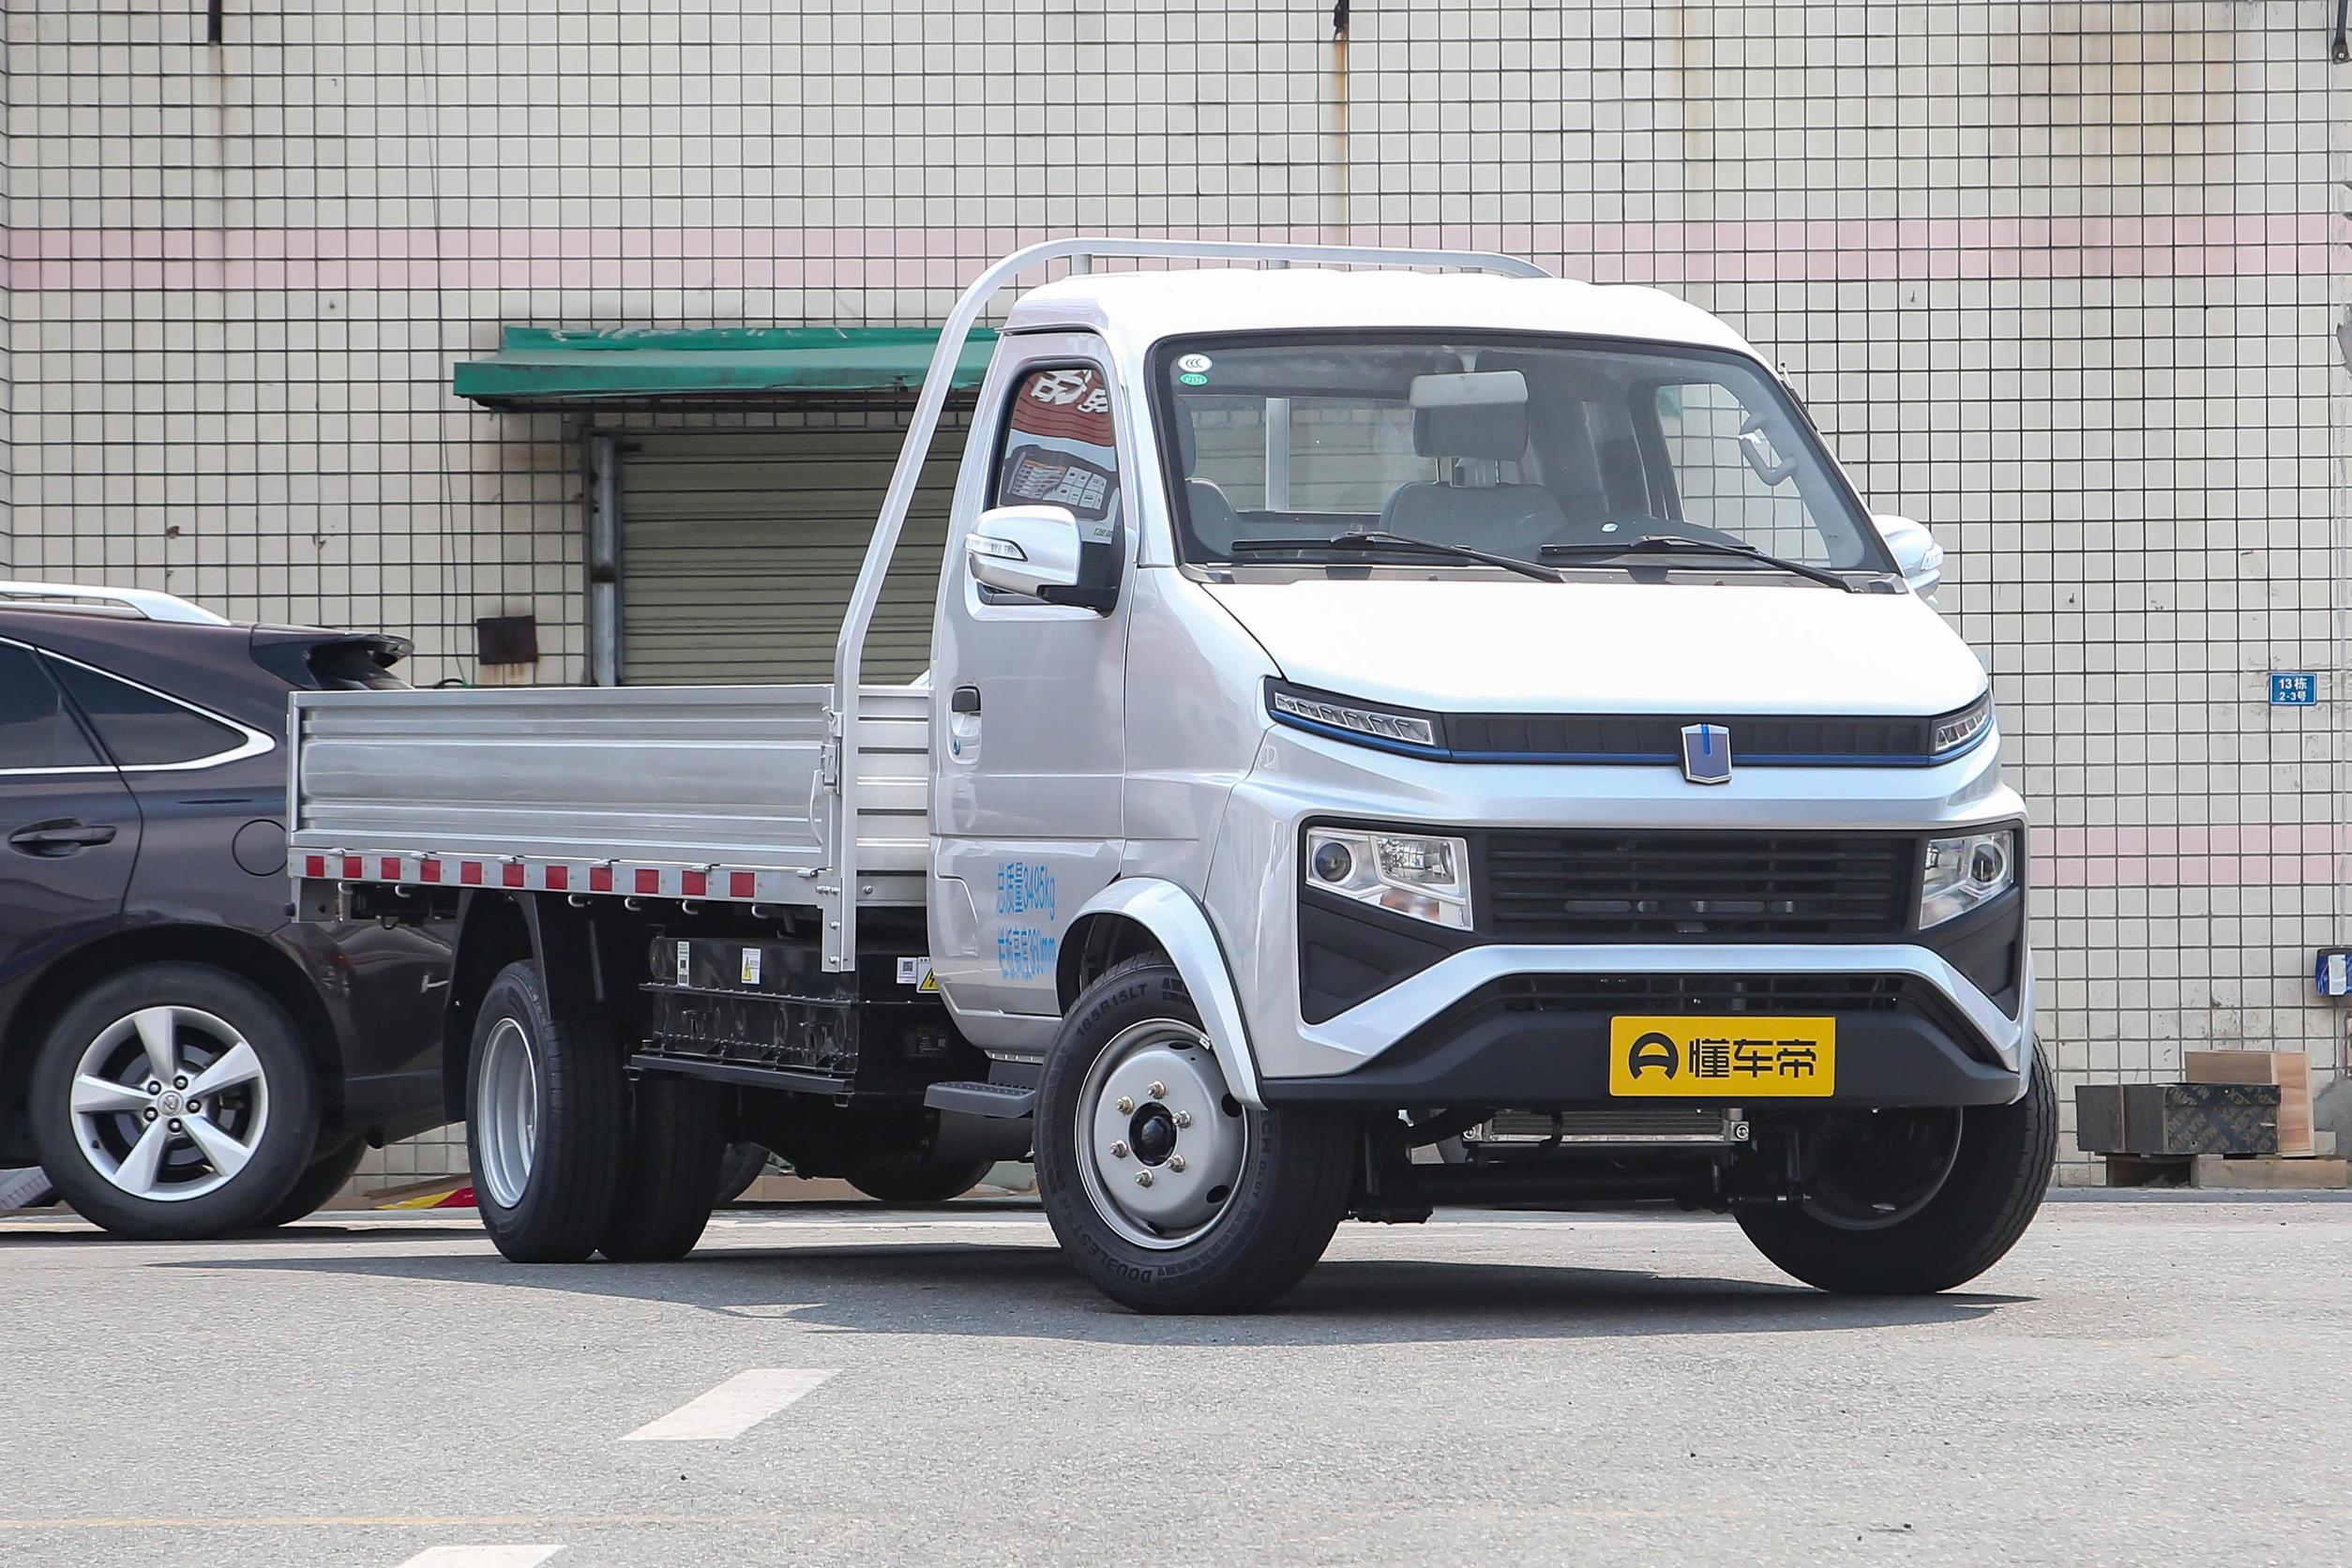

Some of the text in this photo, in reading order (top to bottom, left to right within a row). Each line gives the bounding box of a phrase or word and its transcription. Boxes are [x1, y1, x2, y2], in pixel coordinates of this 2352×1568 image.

[2279, 677, 2308, 690] 13栋
[2279, 690, 2307, 702] 2-3号
[997, 861, 1056, 921] 总质量3495kg
[1688, 1037, 1817, 1079] 懂车帝
